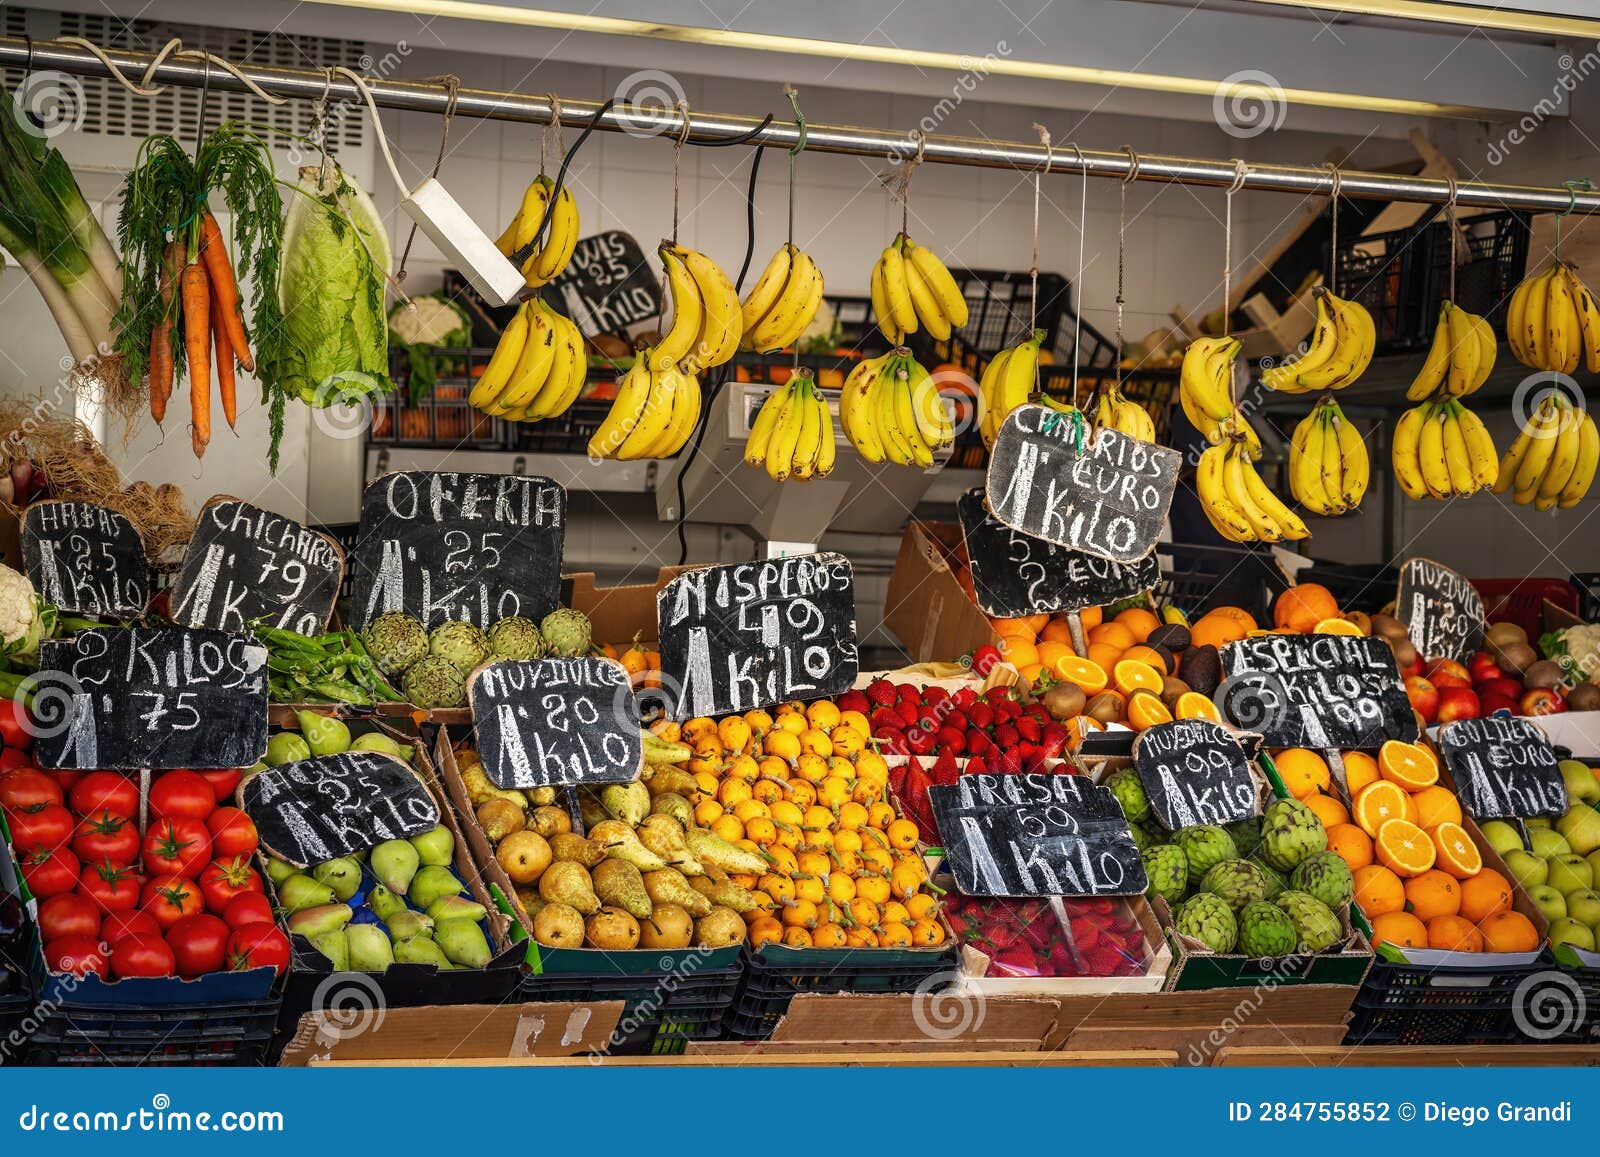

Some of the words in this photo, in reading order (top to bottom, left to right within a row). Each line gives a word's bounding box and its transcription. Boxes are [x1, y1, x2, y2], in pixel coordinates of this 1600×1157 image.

[386, 472, 562, 529] OFERTA
[670, 557, 850, 627] NISPEROS
[958, 773, 1084, 810] FRESA
